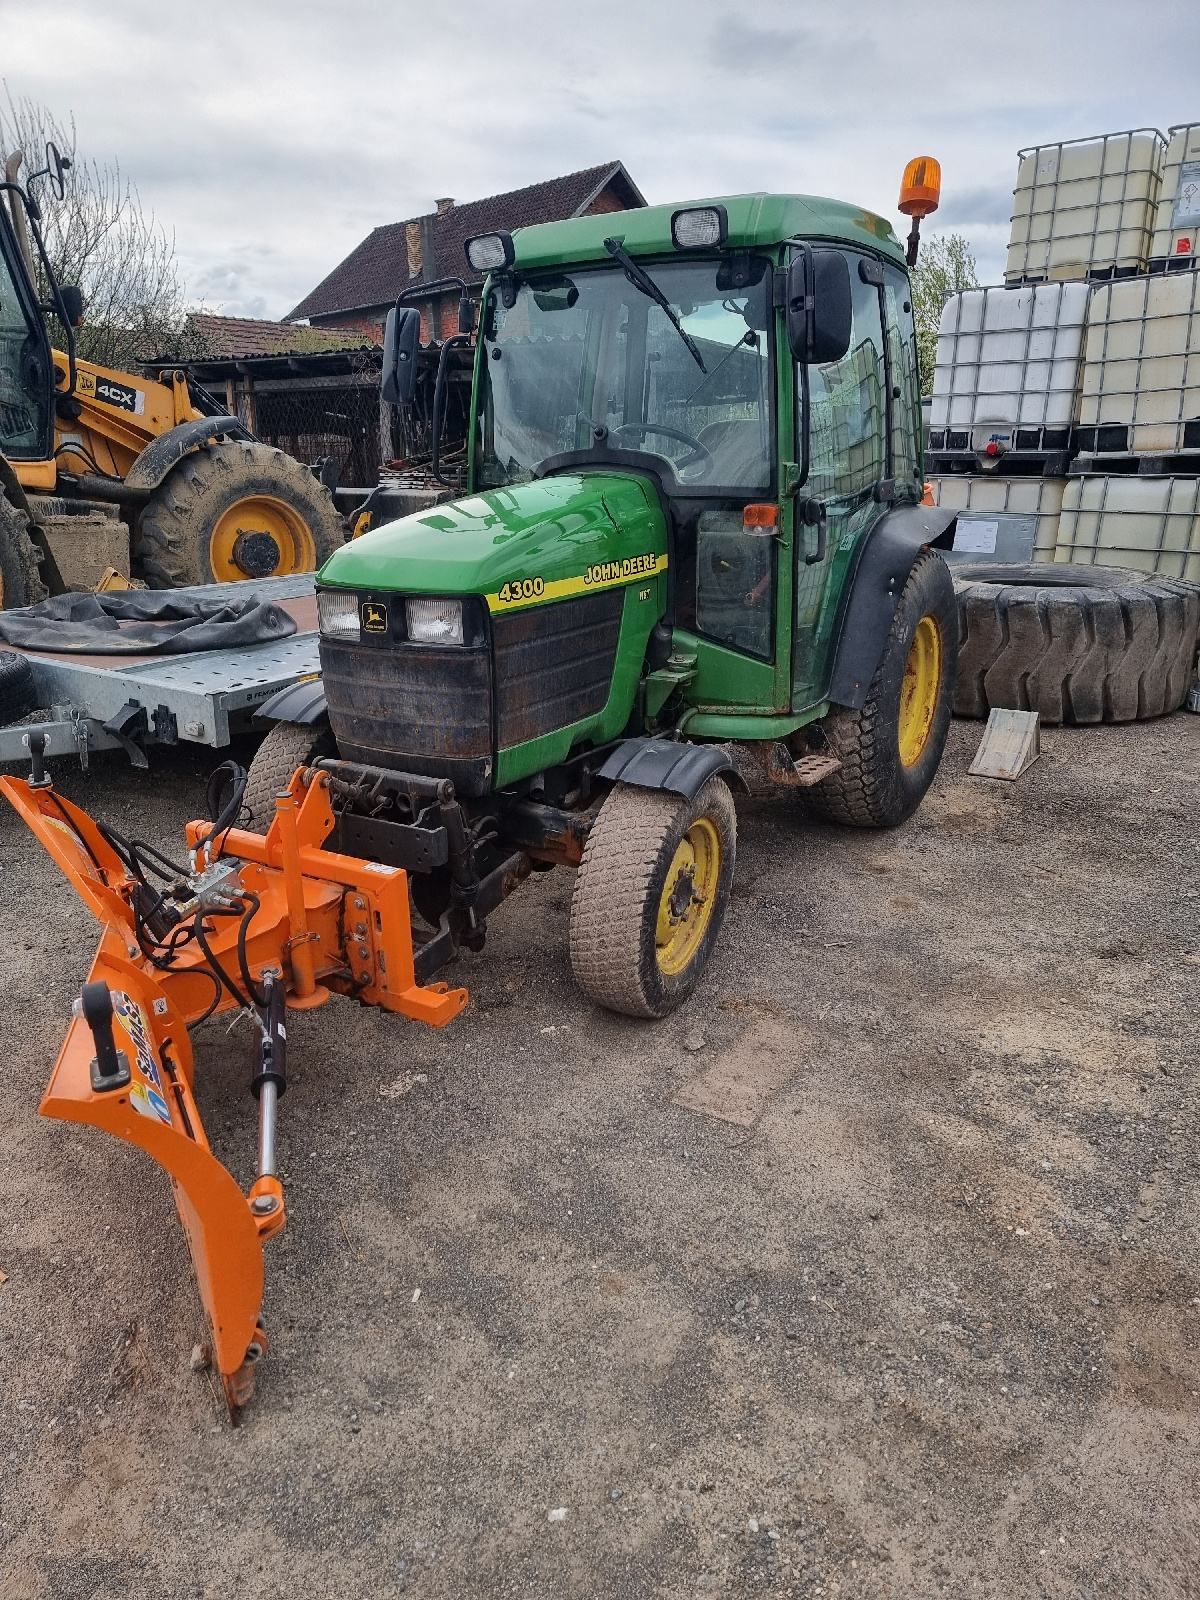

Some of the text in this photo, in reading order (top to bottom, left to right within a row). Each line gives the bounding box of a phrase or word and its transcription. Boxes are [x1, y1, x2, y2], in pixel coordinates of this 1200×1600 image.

[97, 385, 133, 406] 4CX
[584, 554, 657, 585] JOHN DEERE
[498, 577, 545, 602] 4300
